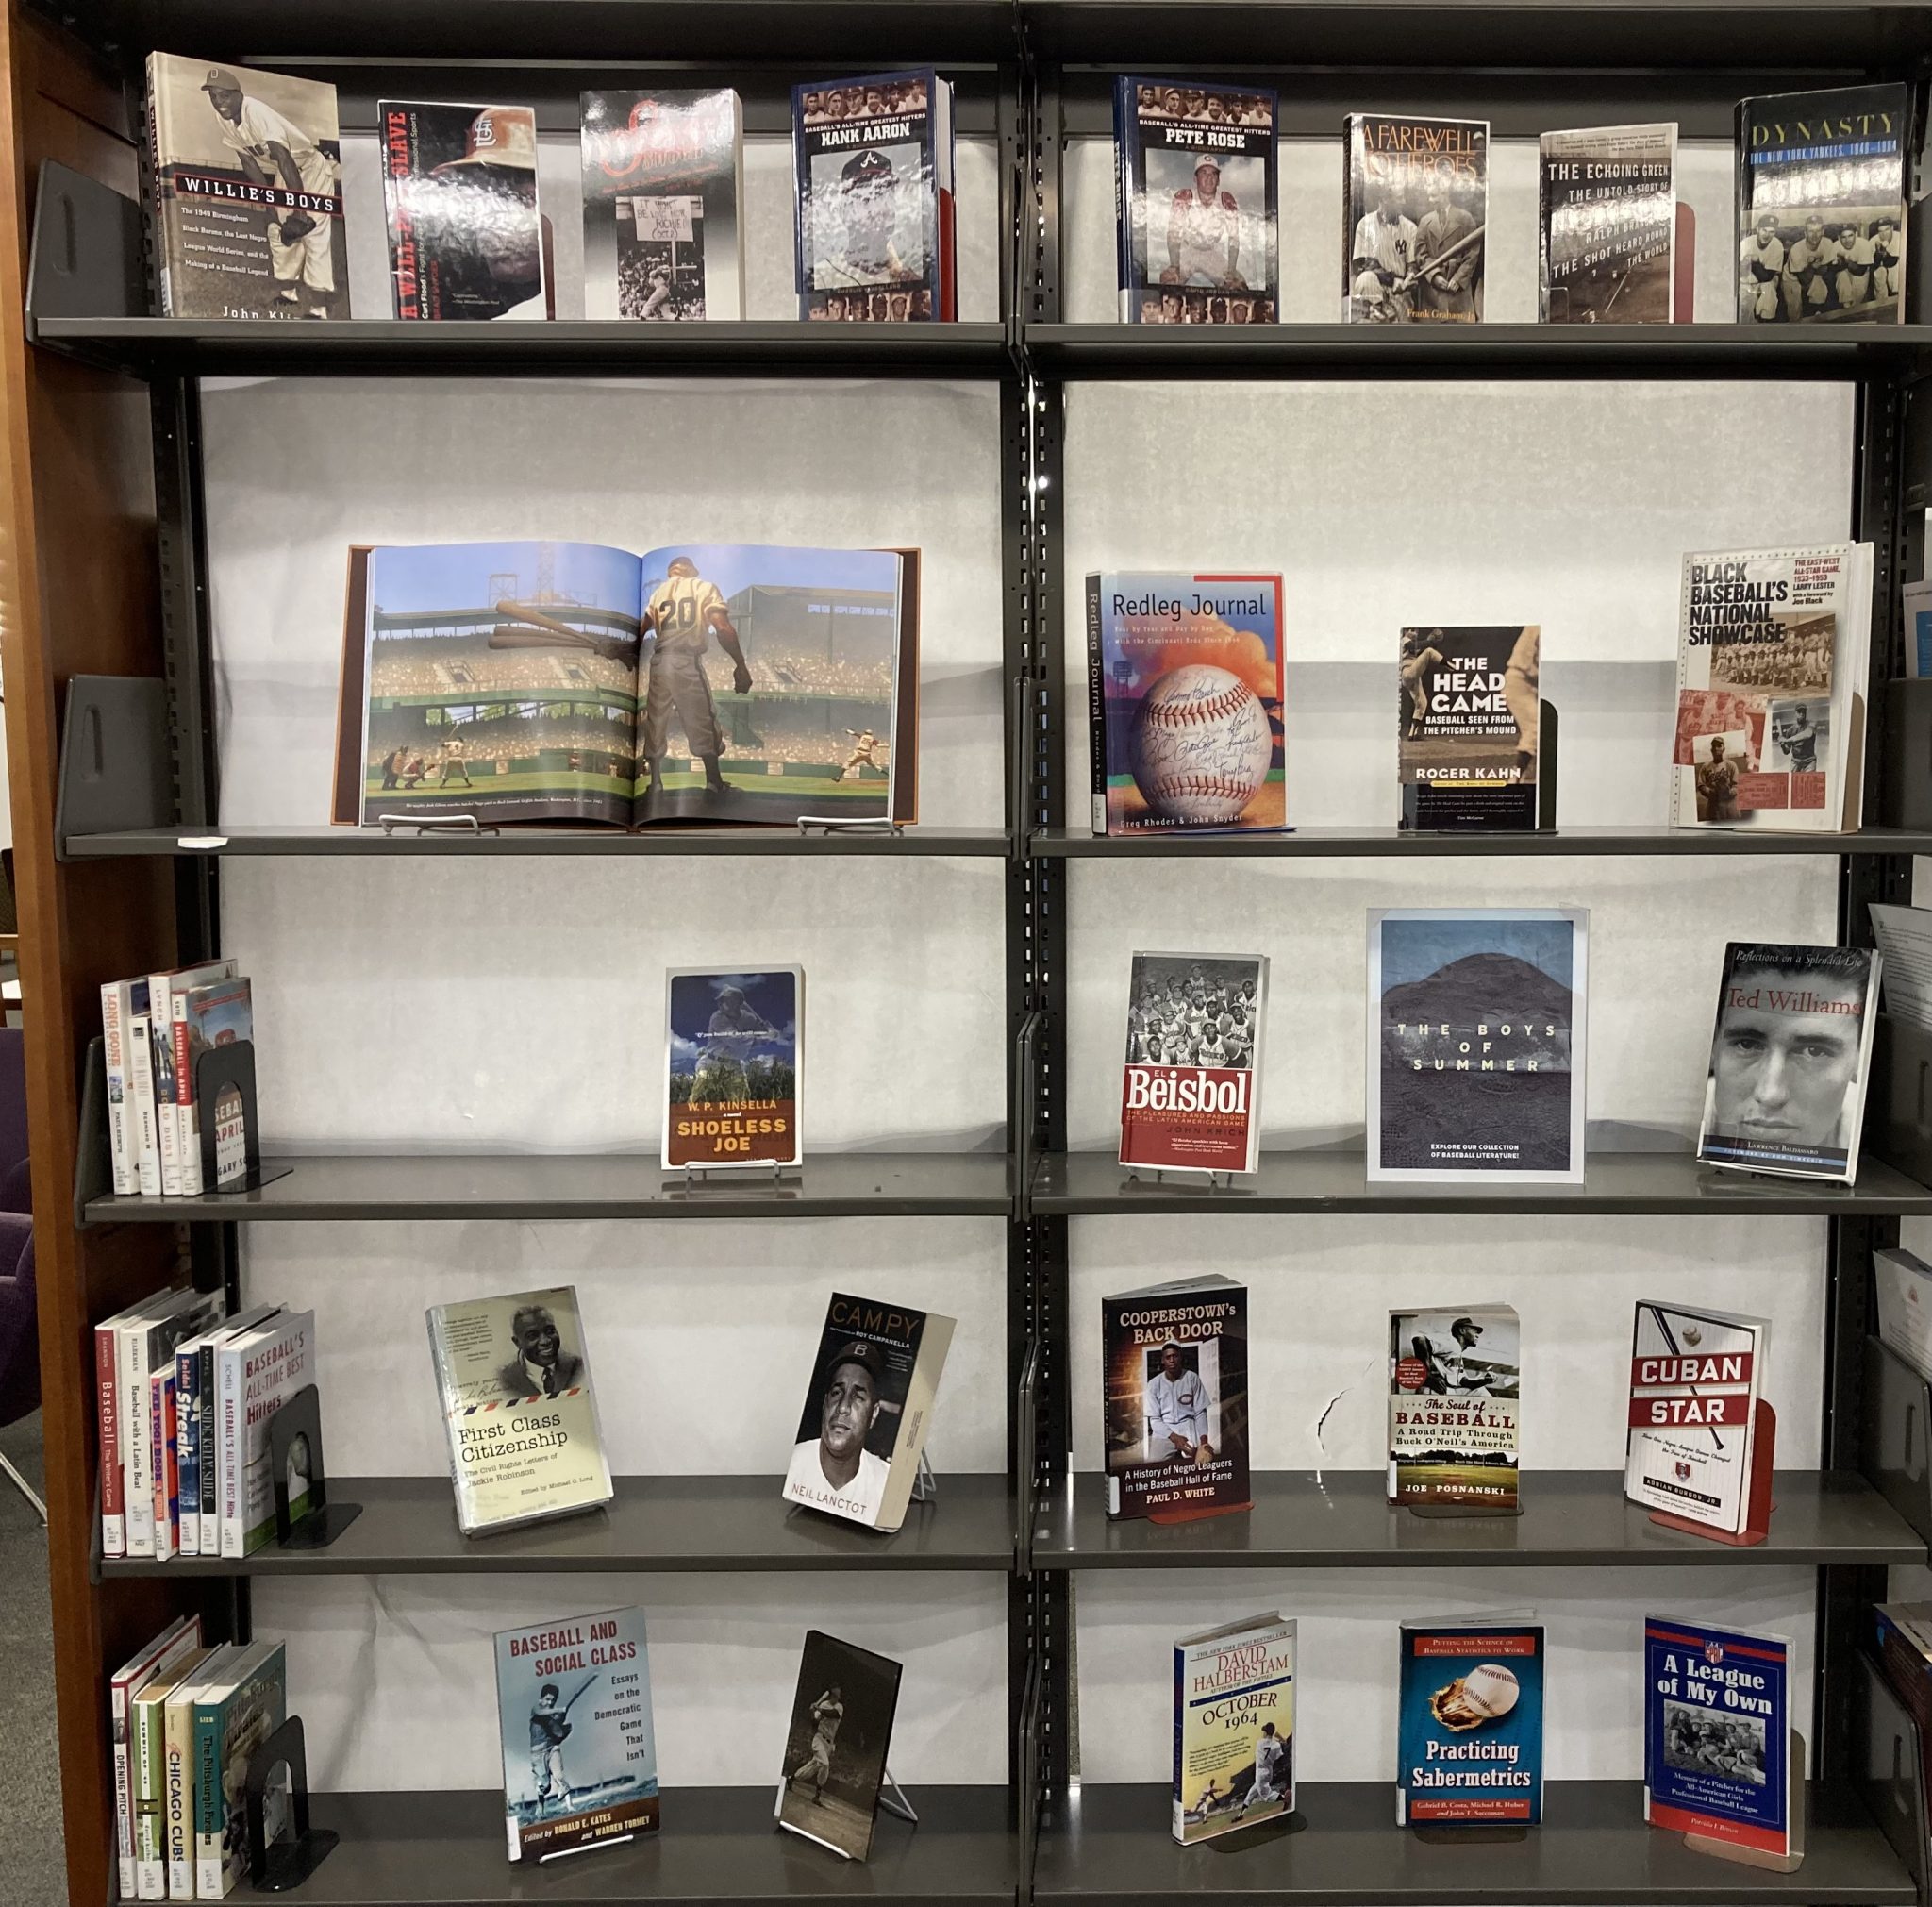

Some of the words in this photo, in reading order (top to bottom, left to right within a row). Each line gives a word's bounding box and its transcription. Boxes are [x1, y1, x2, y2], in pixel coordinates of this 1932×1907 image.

[805, 124, 841, 133] BASEBALL'S
[841, 121, 869, 129] ALL-TIME
[870, 116, 900, 125] GREATEST
[901, 112, 926, 122] HITTERS
[1752, 112, 1894, 147] DYNASTY
[389, 112, 409, 176] SLAVE
[821, 129, 859, 146] HANK
[863, 123, 910, 142] AARON
[1166, 128, 1204, 145] PETE
[1208, 133, 1245, 148] ROSE
[1364, 124, 1374, 148] A
[1378, 125, 1475, 156] FAREWELL
[1548, 164, 1579, 180] THE
[1587, 164, 1639, 179] ECHOING
[1642, 164, 1668, 177] GREEN
[185, 177, 275, 203] WILLIE'S
[285, 192, 334, 211] BOYS
[1569, 190, 1591, 203] THE
[1597, 186, 1633, 199] UNTOLD
[1635, 183, 1658, 193] STORY
[1660, 181, 1668, 190] OF
[1553, 259, 1578, 278] THE
[1584, 246, 1611, 267] SHOT
[1616, 236, 1642, 256] HEARD
[1645, 228, 1668, 244] ROUND
[1627, 255, 1641, 268] THE
[1645, 243, 1668, 260] WORLD
[1691, 562, 1748, 585] BLACK
[1690, 580, 1788, 606] BASEBALL'S
[1812, 581, 1835, 590] LESTER
[660, 597, 697, 629] 20
[1112, 594, 1182, 622] Redleg
[1191, 593, 1266, 616] Journal
[1690, 603, 1774, 626] NATIONAL
[1089, 594, 1098, 651] Redleg
[1688, 623, 1786, 646] SHOWCASE
[1452, 657, 1488, 671] THE
[1091, 659, 1102, 721] Journal
[1433, 673, 1506, 692] HEAD
[1431, 694, 1507, 712] GAME
[1424, 726, 1439, 735] THE
[1441, 726, 1483, 735] PITCHER'S
[1485, 726, 1517, 734] MOUND
[1425, 715, 1465, 725] BASEBALL
[1468, 715, 1488, 724] SEEN
[1491, 715, 1514, 724] FROM
[1416, 768, 1471, 779] ROGER
[1475, 767, 1521, 778] KAHN
[106, 994, 118, 1029] LONG
[1728, 988, 1760, 1009] Ted
[1767, 991, 1863, 1015] Williams
[1397, 1024, 1450, 1035] THE
[1477, 1024, 1555, 1036] BOYS
[109, 1032, 121, 1067] GONE
[175, 1026, 184, 1064] BASEBALL
[1459, 1042, 1491, 1053] OF
[1413, 1059, 1538, 1071] SUMMER
[1126, 1069, 1247, 1113] Beisbol
[688, 1102, 700, 1112] W.
[704, 1102, 713, 1111] P.
[719, 1100, 777, 1111] KINSELLA
[677, 1119, 787, 1136] SHOELESS
[714, 1136, 750, 1152] JOE
[831, 1301, 920, 1339] CAMPY
[856, 1330, 867, 1339] ROY
[868, 1333, 910, 1349] CAMPANELLA
[1134, 1328, 1175, 1344] BACK
[1180, 1321, 1223, 1339] DOOR
[246, 1332, 304, 1378] BASEBALL'S
[246, 1366, 284, 1401] ALL-TIME
[286, 1353, 304, 1379] BEST
[1641, 1356, 1741, 1382] CUBAN
[102, 1382, 114, 1444] Baseball
[131, 1385, 140, 1418] Baseball
[247, 1394, 282, 1426] Hitters
[1424, 1399, 1443, 1409] The
[1446, 1400, 1471, 1410] Soul
[1473, 1401, 1485, 1414] of
[1651, 1399, 1724, 1423] STAR
[176, 1391, 193, 1459] Streak
[458, 1424, 506, 1445] First
[511, 1414, 561, 1432] Class
[1396, 1413, 1515, 1429] BASEBALL
[1467, 1430, 1512, 1440] Through
[1471, 1440, 1514, 1448] America
[462, 1431, 568, 1464] Citizenship
[1125, 1470, 1131, 1480] A
[1133, 1467, 1161, 1481] History
[1163, 1465, 1171, 1475] of
[1174, 1463, 1196, 1477] Negro
[1198, 1459, 1232, 1474] Leaguers
[1126, 1483, 1133, 1493] in
[1136, 1481, 1148, 1491] the
[1150, 1477, 1183, 1489] Baseball
[1186, 1475, 1200, 1485] Hall
[1203, 1473, 1210, 1483] of
[1212, 1470, 1232, 1481] Fame
[792, 1483, 814, 1499] NEIL
[817, 1493, 867, 1515] LANCTOT
[1147, 1493, 1170, 1504] PAUL
[1173, 1491, 1182, 1500] D.
[1185, 1487, 1215, 1498] WHITE
[1436, 1485, 1505, 1495] POSNANSKI
[510, 1628, 584, 1657] BASEBALL
[591, 1620, 617, 1641] AND
[535, 1654, 586, 1677] SOCIAL
[591, 1642, 637, 1665] CLASS
[1217, 1646, 1267, 1671] DAVID
[611, 1672, 639, 1685] Essays
[1193, 1654, 1289, 1692] HALBERSTAM
[1664, 1654, 1678, 1673] A
[1687, 1659, 1765, 1690] League
[614, 1692, 624, 1700] on
[626, 1688, 640, 1698] the
[1658, 1679, 1678, 1696] of
[1687, 1681, 1717, 1706] My
[1724, 1690, 1773, 1715] Own
[594, 1704, 641, 1721] Democratic
[1202, 1692, 1277, 1725] OCTOBER
[620, 1719, 641, 1731] Game
[1225, 1712, 1258, 1731] 1964
[626, 1734, 643, 1746] That
[627, 1749, 644, 1761] Isn't
[1426, 1741, 1519, 1763] Practicing
[116, 1755, 126, 1790] OPENING
[1412, 1767, 1531, 1786] Sabermetrics
[169, 1751, 181, 1821] CHICAGO
[118, 1792, 128, 1815] PITCH
[172, 1828, 184, 1861] CUBS
